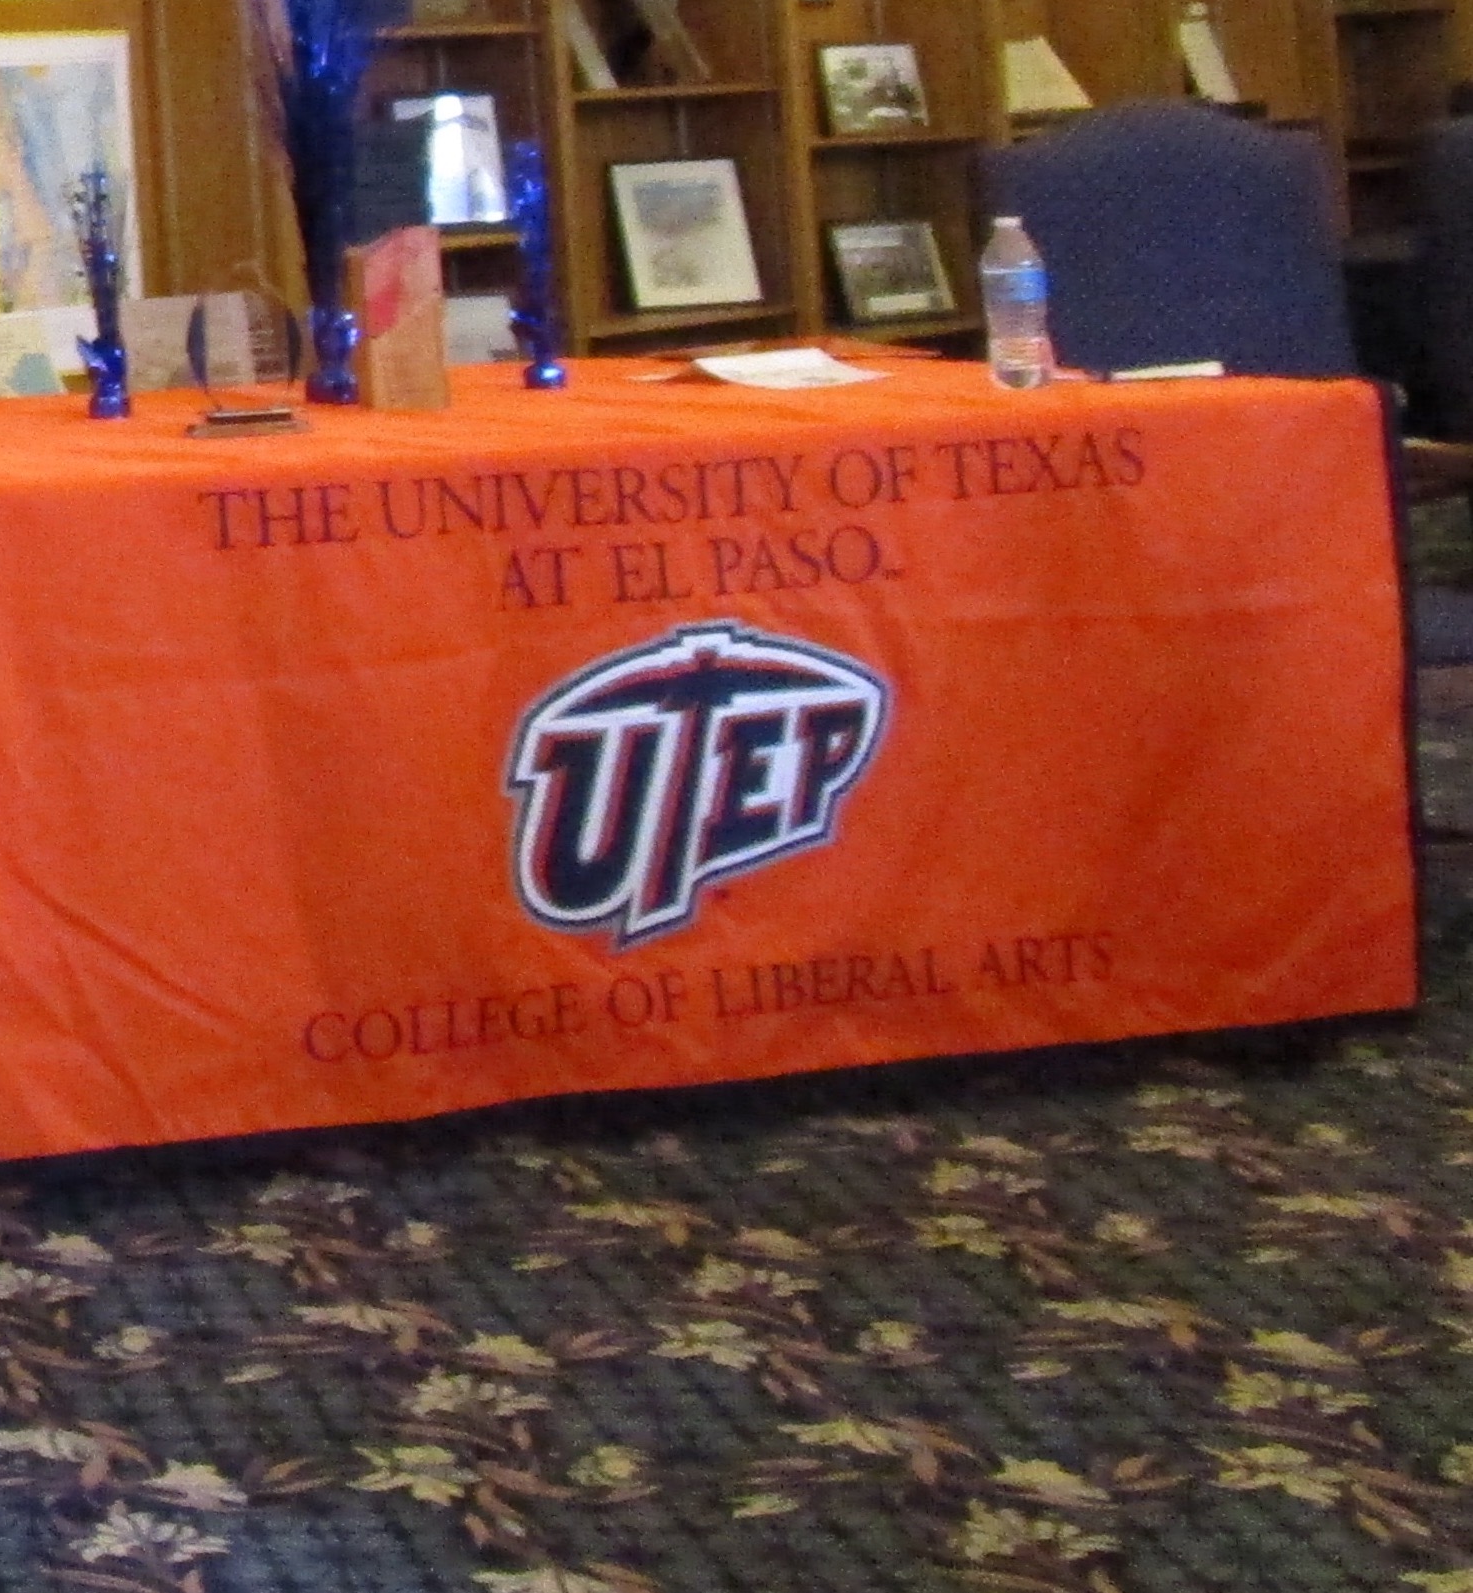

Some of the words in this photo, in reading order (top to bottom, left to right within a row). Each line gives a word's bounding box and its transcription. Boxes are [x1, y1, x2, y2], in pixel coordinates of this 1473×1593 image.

[199, 483, 358, 551] THE
[377, 455, 803, 539] UNIVERSITY
[830, 446, 918, 508] OF
[937, 428, 1146, 501] TEXAS
[502, 546, 583, 609] AT
[610, 542, 694, 603] EL
[707, 525, 881, 596] PASO
[529, 646, 875, 918] UTEP
[304, 981, 586, 1063] COLLEGE
[606, 969, 689, 1026] OF
[711, 946, 958, 1019] LIBERAL
[979, 930, 1114, 988] ARTS
